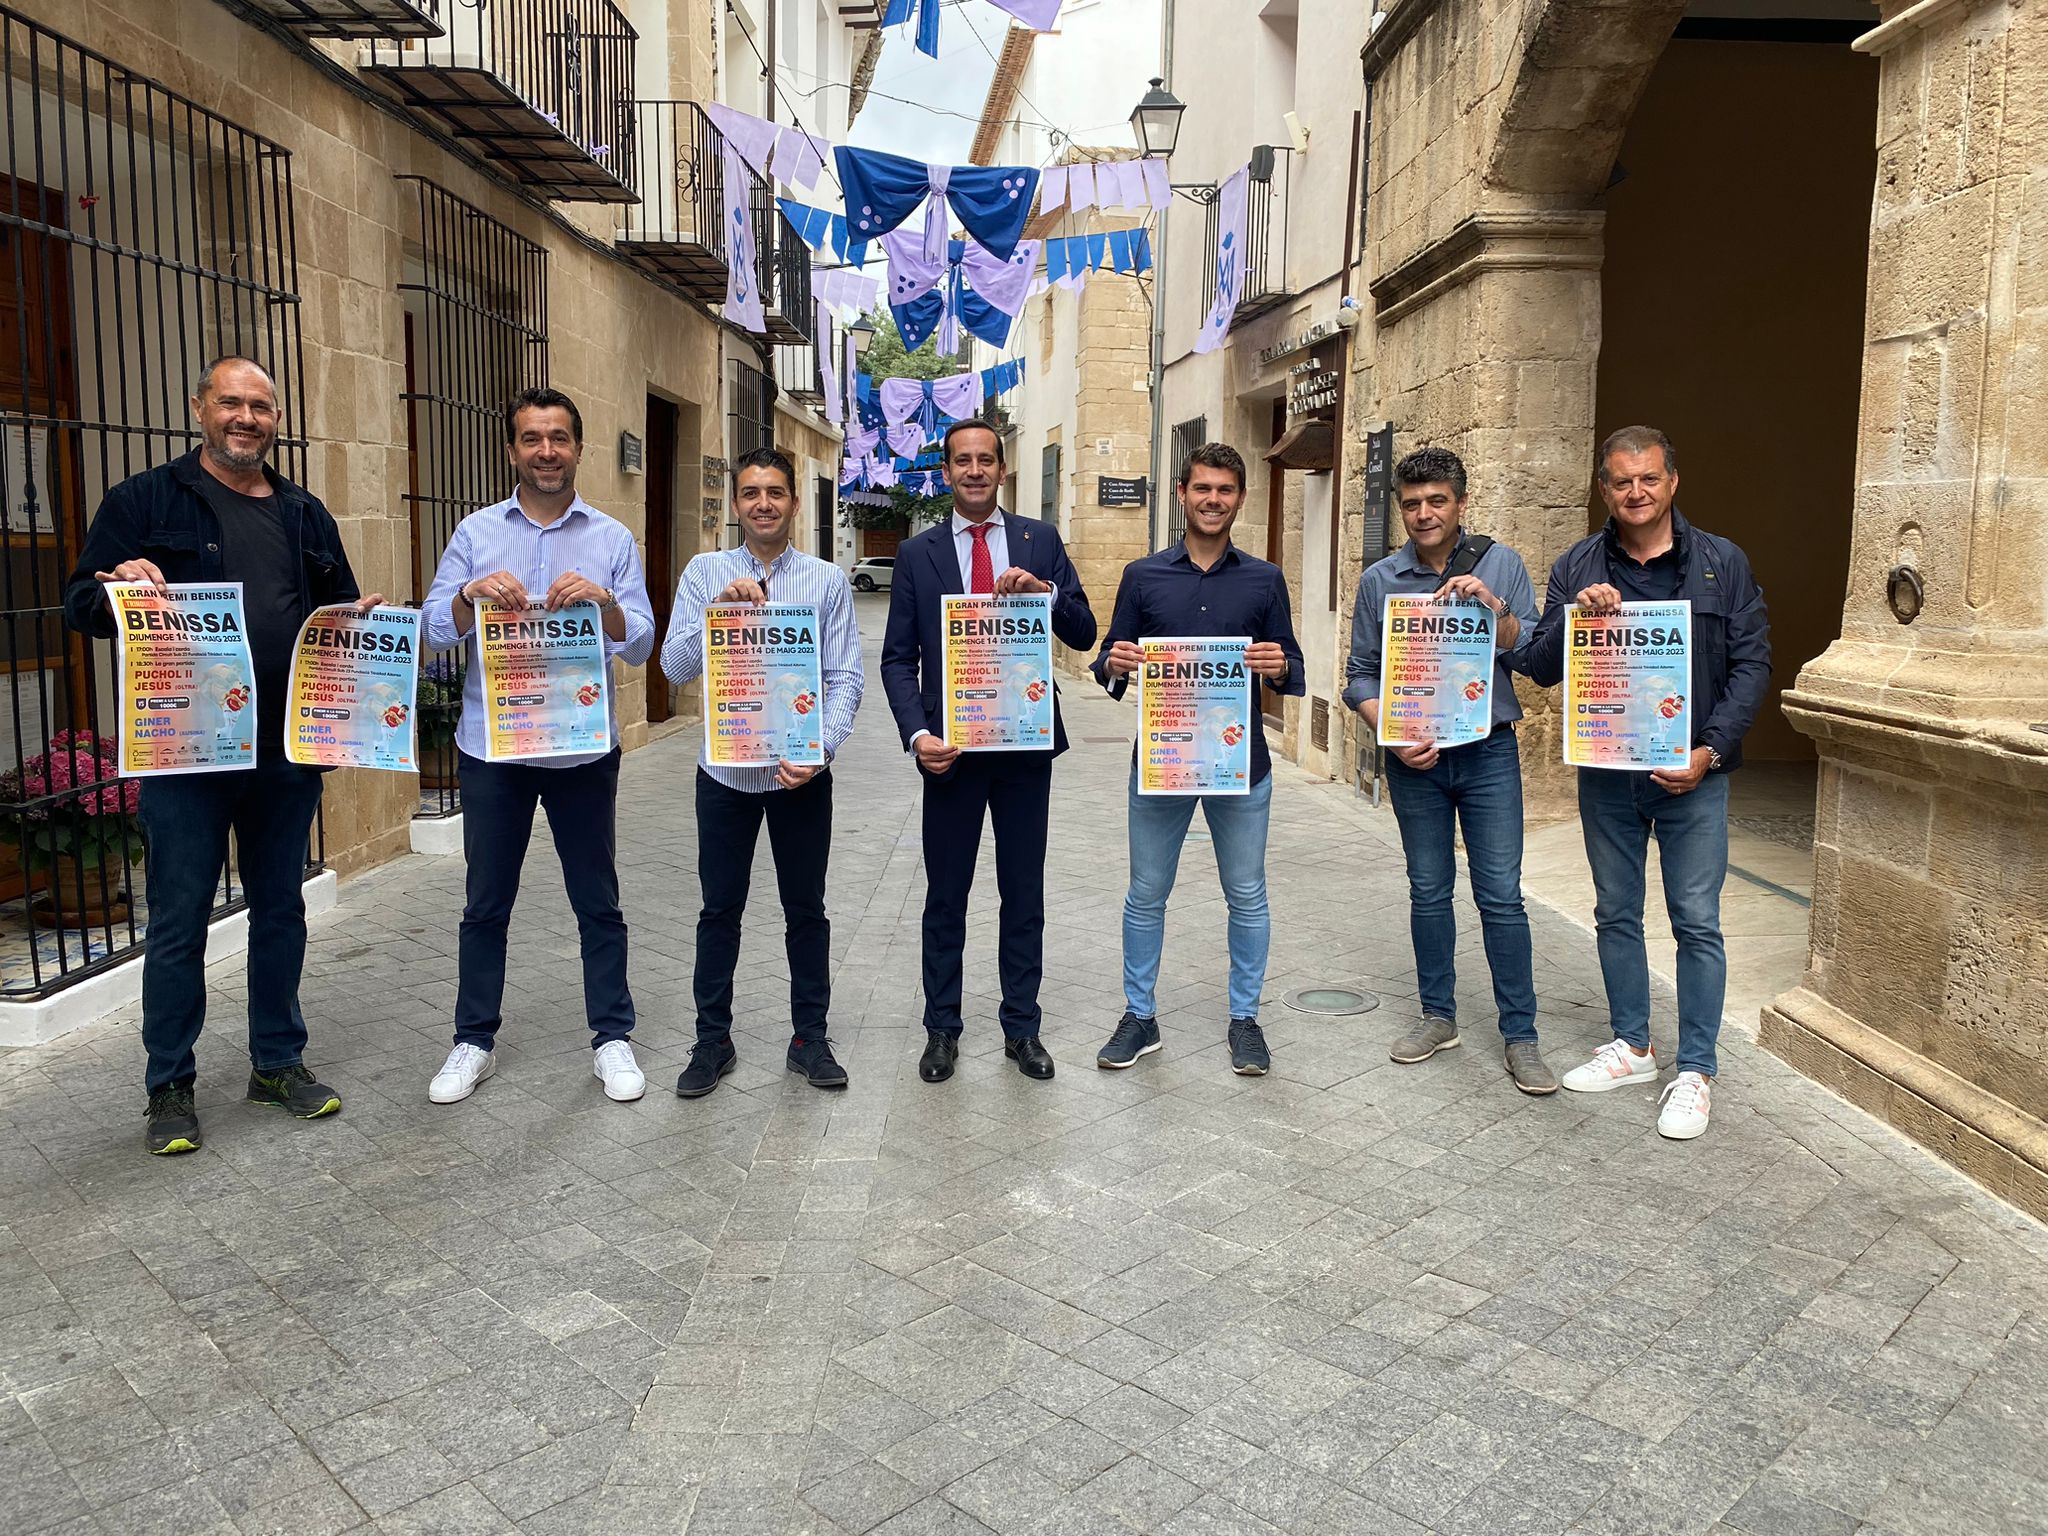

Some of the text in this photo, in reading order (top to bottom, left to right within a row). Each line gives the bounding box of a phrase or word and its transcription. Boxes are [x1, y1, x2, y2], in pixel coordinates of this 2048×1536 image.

[1369, 460, 1383, 474] Consell
[192, 592, 236, 600] BENISSA
[125, 610, 239, 632] BENISSA
[341, 611, 369, 620] PREMI
[372, 614, 414, 624] BENISSA
[486, 619, 595, 641] BENISSA
[950, 618, 1045, 636] BENISSA
[1392, 618, 1490, 634] BENISSA
[303, 627, 411, 654] BENISSA
[711, 627, 813, 646] BENISSA
[1574, 628, 1683, 646] BENISSA
[301, 648, 340, 658] DIUMENGE
[342, 651, 354, 659] 14
[370, 654, 392, 662] MAIG
[135, 670, 193, 680] PUCHOL II
[495, 672, 536, 680] PUCHOL
[1147, 662, 1244, 679] BENISSA
[302, 682, 344, 692] PUCHOL
[135, 717, 171, 726] GINER
[499, 722, 533, 730] NACHO
[134, 728, 176, 738] NACHO
[298, 725, 331, 733] GINER
[298, 735, 336, 744] NACHO
